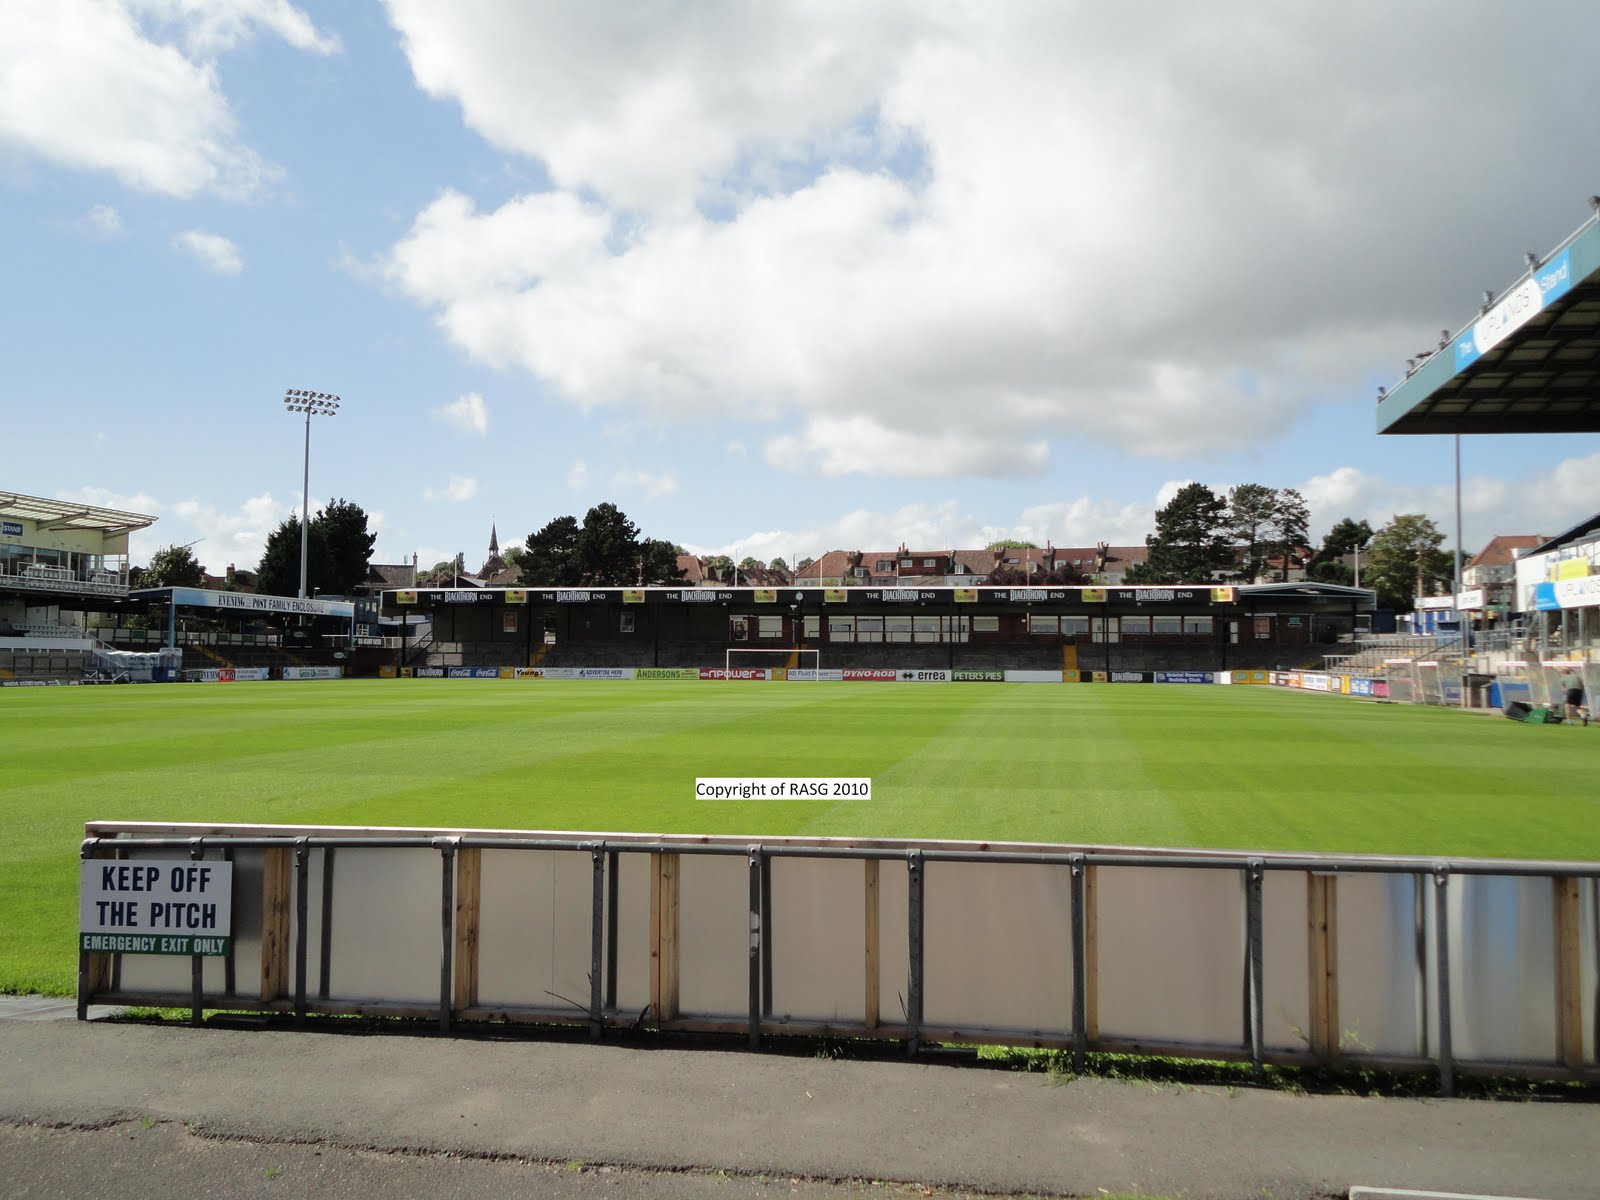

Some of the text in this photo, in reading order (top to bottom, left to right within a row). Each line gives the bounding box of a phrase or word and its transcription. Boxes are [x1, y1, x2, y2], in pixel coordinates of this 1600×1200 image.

[3, 525, 21, 533] STAND
[445, 591, 478, 602] BLACKTHORN
[556, 591, 591, 602] BLACKTHORN
[681, 590, 716, 602] BLACKTHORN
[882, 590, 919, 602] BLACKTHORN
[1010, 590, 1048, 602] BLACKTHORN
[1135, 588, 1175, 601] BLACKTHORN
[218, 594, 325, 613] EVENING POST FAMILY ENCLOSURE
[516, 669, 544, 677] Young's
[636, 669, 681, 678] ANDERSONS
[708, 669, 756, 678] npower
[843, 670, 896, 678] DYNO-ROD
[917, 671, 946, 680] errea
[985, 672, 1002, 680] PIES
[102, 866, 212, 893] KEEP OFF
[96, 901, 216, 929] THE PITCH
[83, 935, 225, 954] EMERGENCY EXIT ONLY
